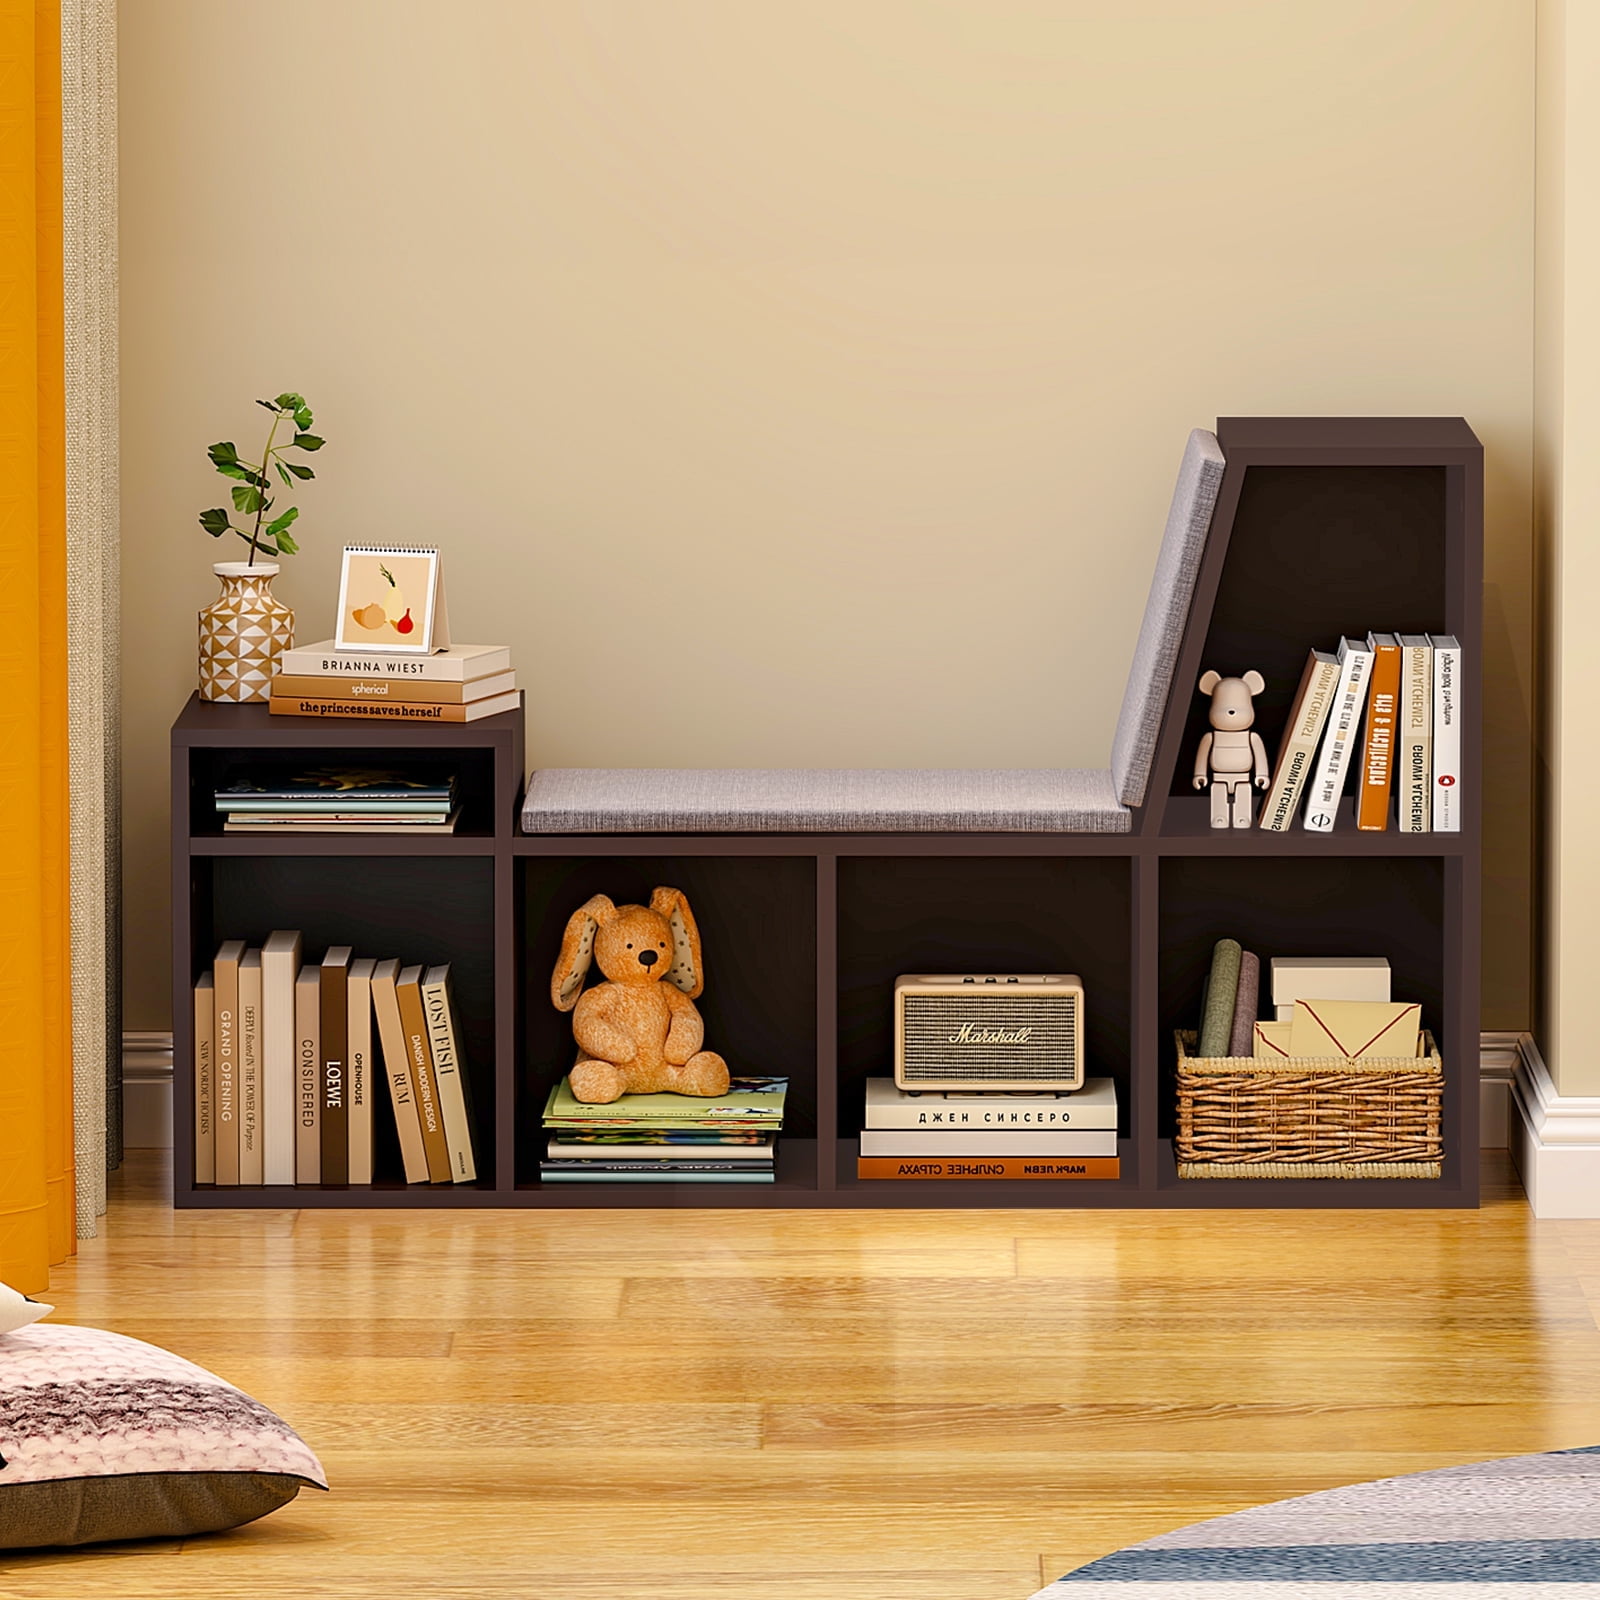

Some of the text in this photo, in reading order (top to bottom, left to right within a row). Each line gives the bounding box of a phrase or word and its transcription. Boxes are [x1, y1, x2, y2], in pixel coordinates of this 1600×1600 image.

[322, 660, 424, 673] BRIANNA WIEST
[351, 683, 388, 695] spherical
[300, 702, 442, 718] the princess saves herself
[245, 1006, 255, 1034] DEEPLY
[426, 988, 455, 1075] LOST FISH
[949, 1022, 1032, 1044] Marshall
[220, 1010, 232, 1122] GRAND OPENING
[245, 1057, 254, 1066] IN
[245, 1067, 255, 1083] THE
[200, 1040, 209, 1135] NEW NORDIC HOUSES
[302, 1039, 313, 1128] CONSIDERED
[326, 1060, 341, 1108] LOEWE
[354, 1053, 362, 1106] OPENHOUSE
[392, 1072, 410, 1105] RUM
[411, 1034, 437, 1132] DANISH MODERN DESIGN
[245, 1084, 255, 1111] POWER
[245, 1111, 255, 1123] OF
[918, 1112, 1072, 1123] ДЖЕН СИНСЕРО
